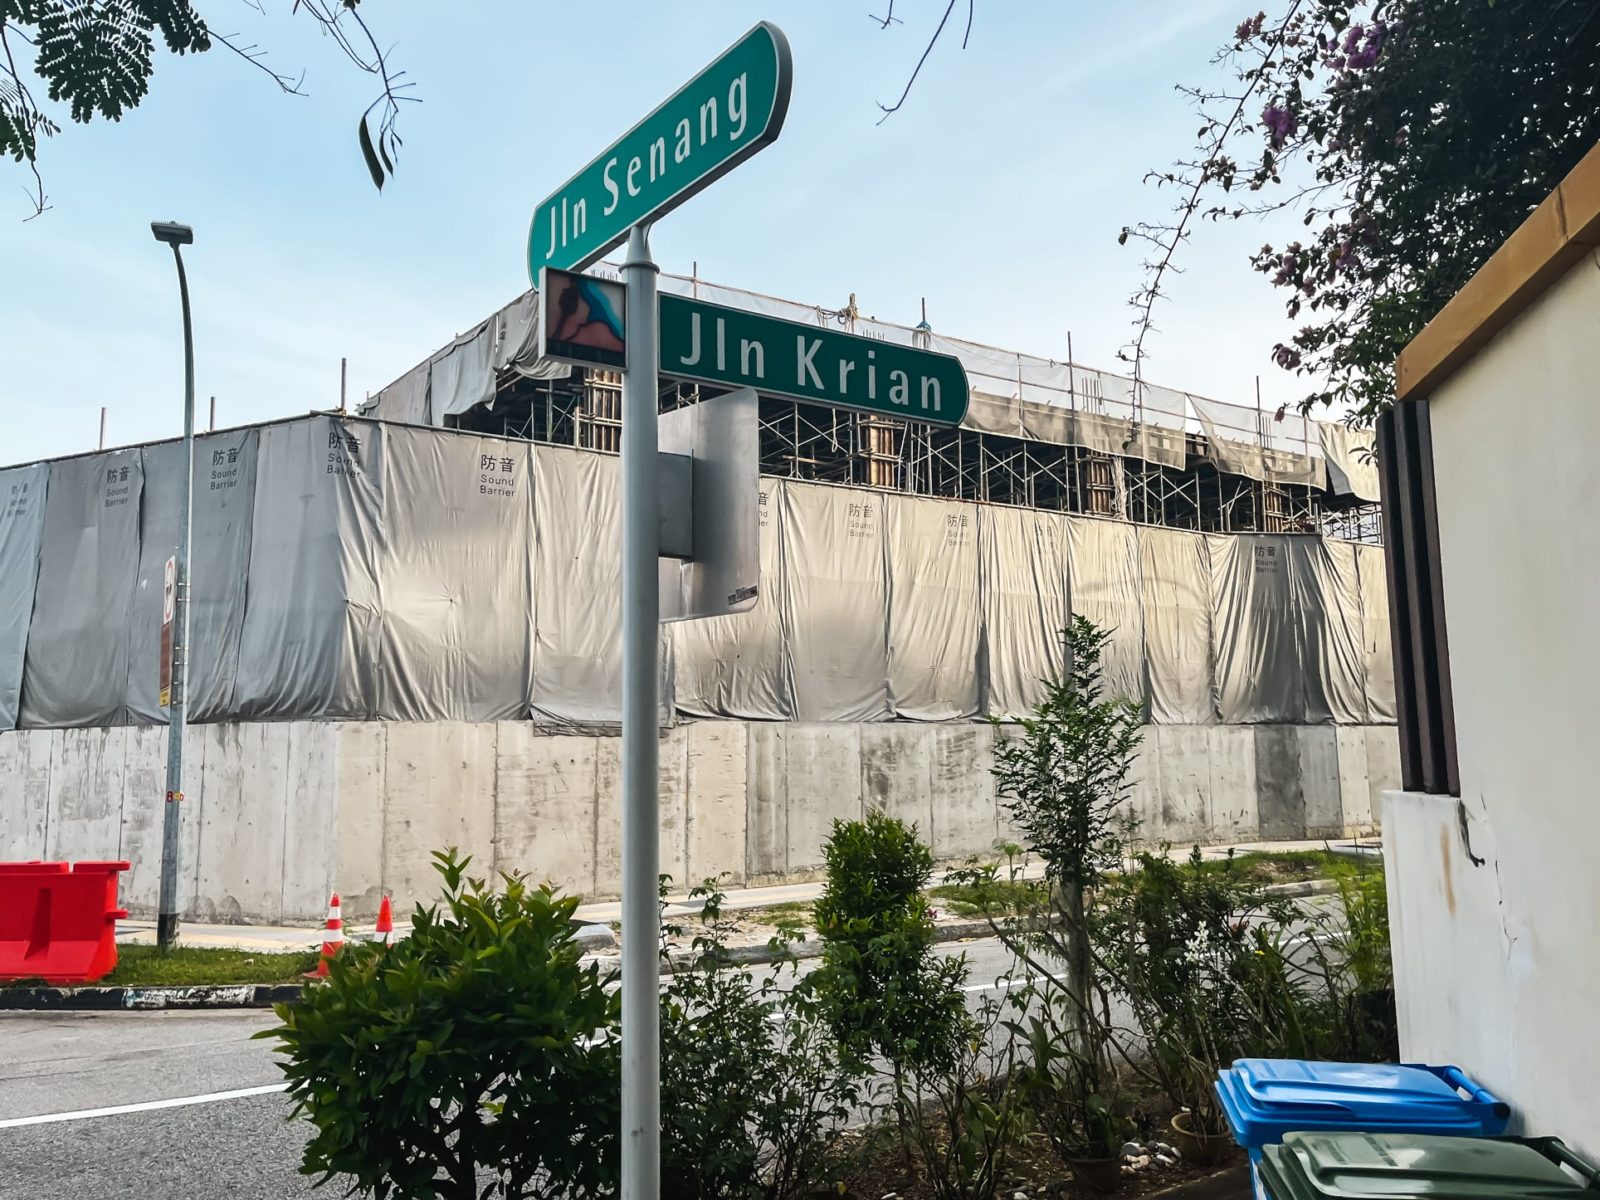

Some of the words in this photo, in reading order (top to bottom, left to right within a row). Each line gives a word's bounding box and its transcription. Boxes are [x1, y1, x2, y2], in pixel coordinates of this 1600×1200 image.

[546, 197, 586, 259] Jln
[603, 72, 748, 216] Senang
[680, 312, 764, 378] Jln
[797, 335, 941, 411] Krian
[212, 448, 240, 466] 防音
[480, 454, 515, 473] 防音
[107, 465, 130, 484] 防音
[211, 468, 238, 479] Sound
[480, 474, 514, 486] Sound
[210, 480, 238, 490] Barrier
[480, 485, 516, 497] Barrier
